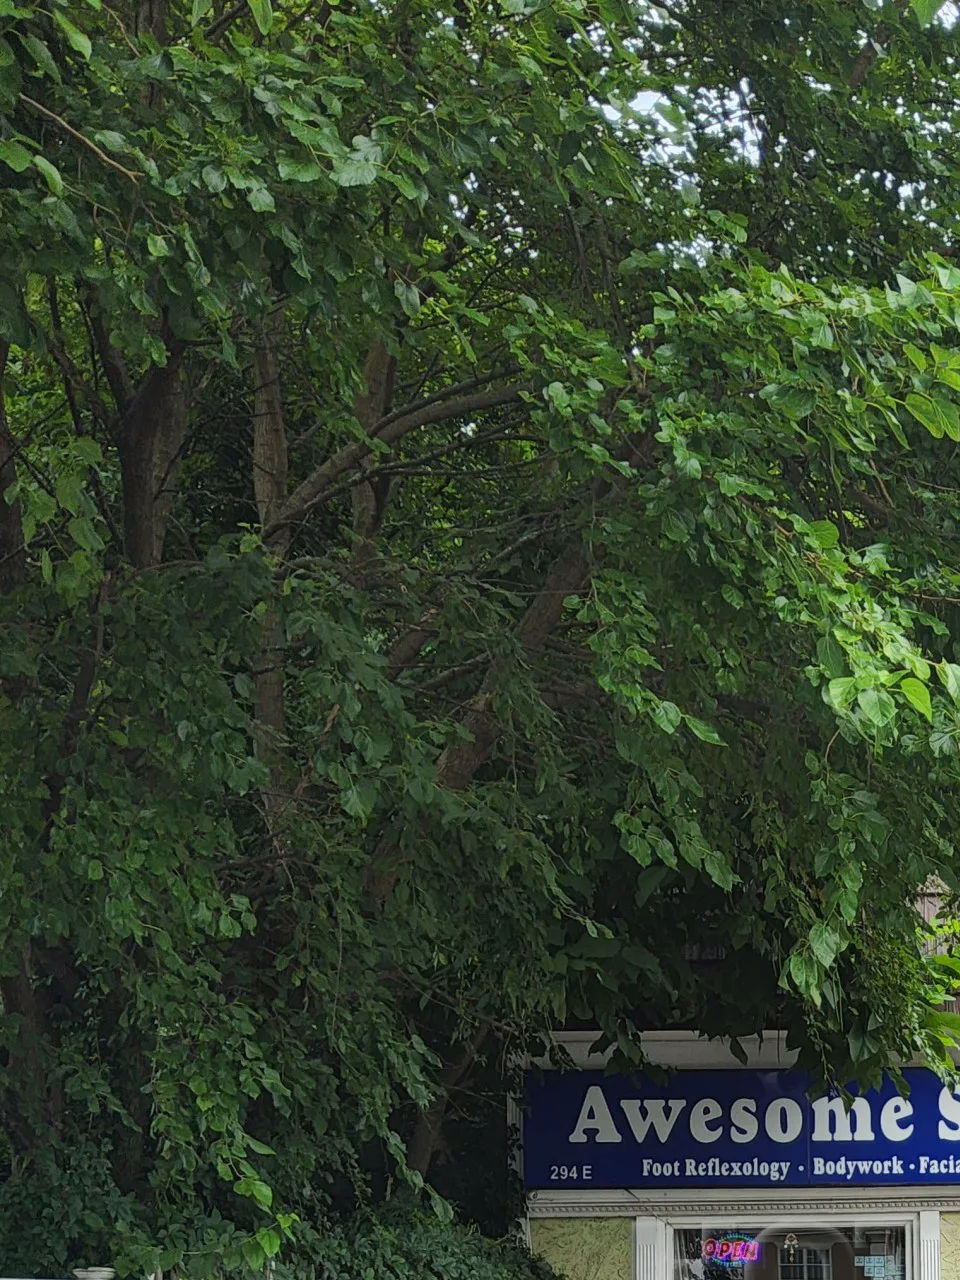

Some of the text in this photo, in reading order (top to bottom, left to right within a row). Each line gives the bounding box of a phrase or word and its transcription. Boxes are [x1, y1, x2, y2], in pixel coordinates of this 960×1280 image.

[569, 1085, 914, 1144] Awesome
[550, 1166, 592, 1180] 294 E
[641, 1158, 681, 1177] Foot
[684, 1157, 791, 1180] Reflexology
[812, 1156, 904, 1180] Bodywork
[703, 1237, 760, 1261] OPEN
